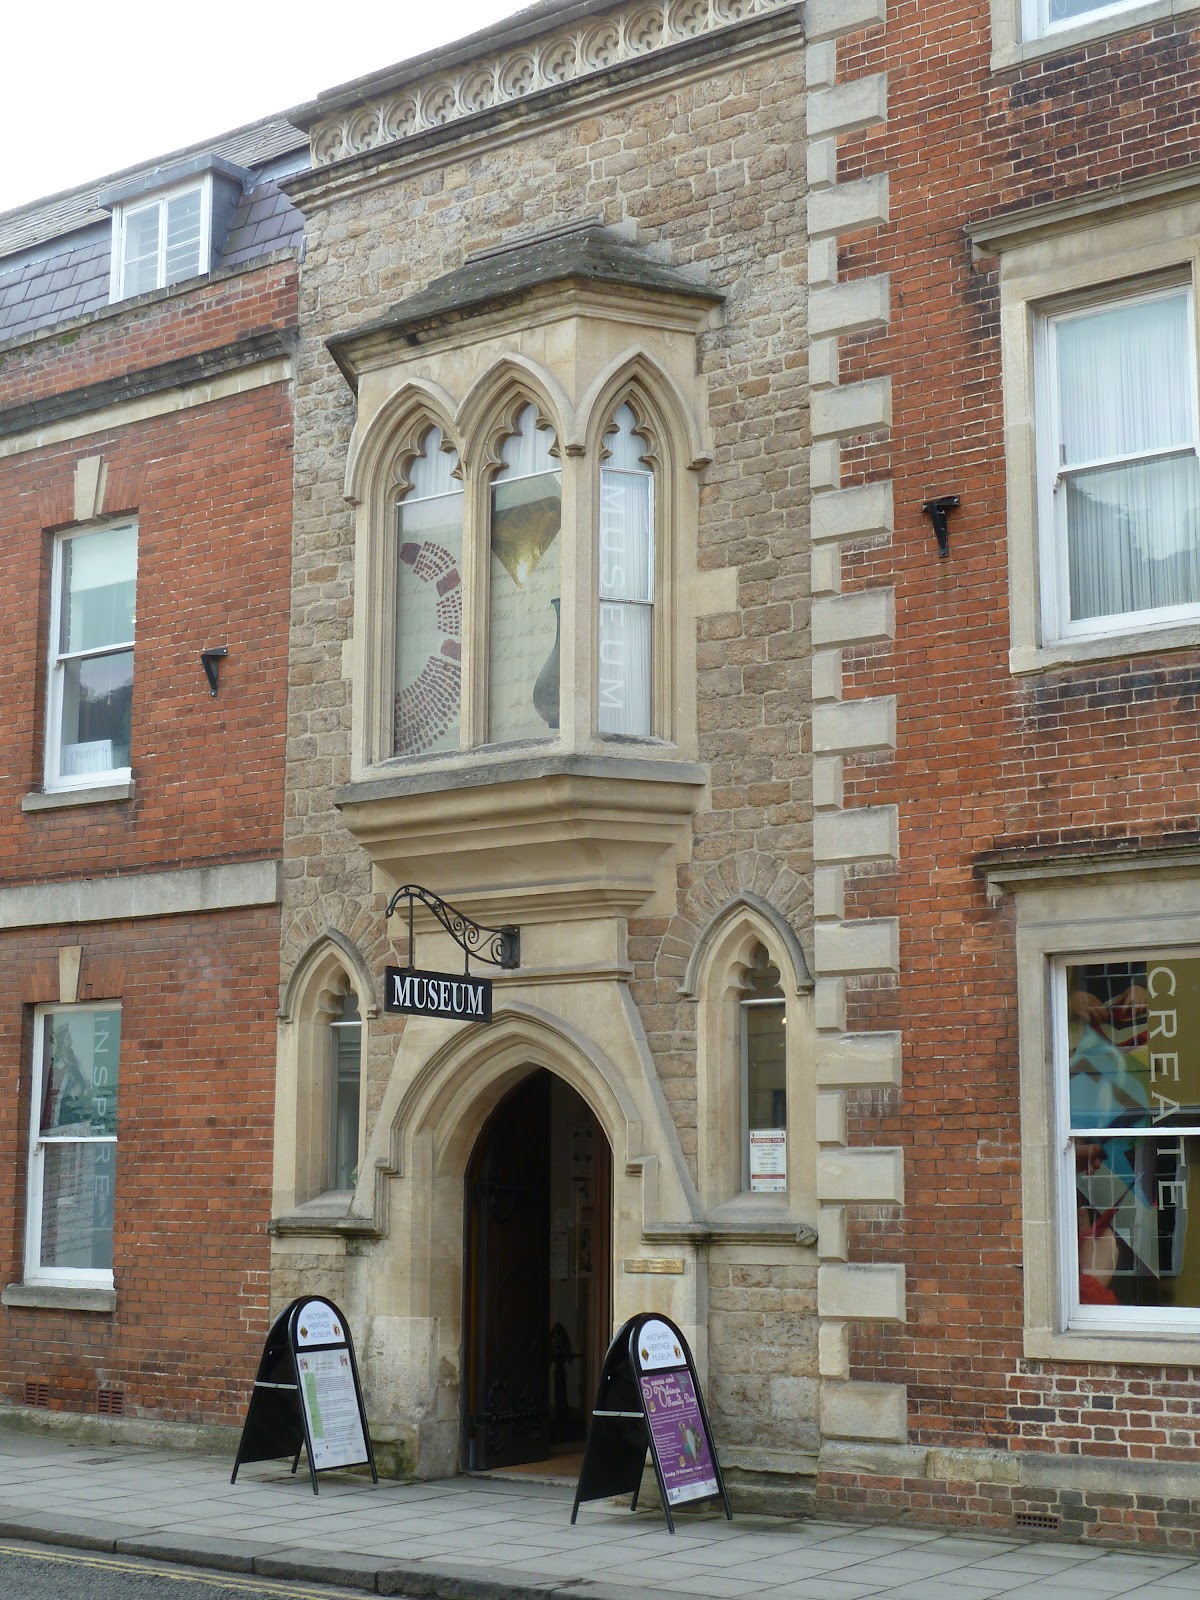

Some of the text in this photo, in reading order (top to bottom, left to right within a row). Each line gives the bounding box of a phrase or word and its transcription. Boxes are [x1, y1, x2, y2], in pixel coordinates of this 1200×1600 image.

[600, 485, 626, 709] MUSEUM
[393, 975, 484, 1015] MUSEUM
[1149, 966, 1188, 1210] CREATE
[92, 1015, 110, 1197] INSPIRE
[306, 1312, 330, 1320] WILTSHIRE
[308, 1321, 330, 1329] HERITAGE
[645, 1332, 669, 1341] WILTSHIRE
[649, 1342, 670, 1351] HERITAGE
[652, 1353, 672, 1361] MUSEUM
